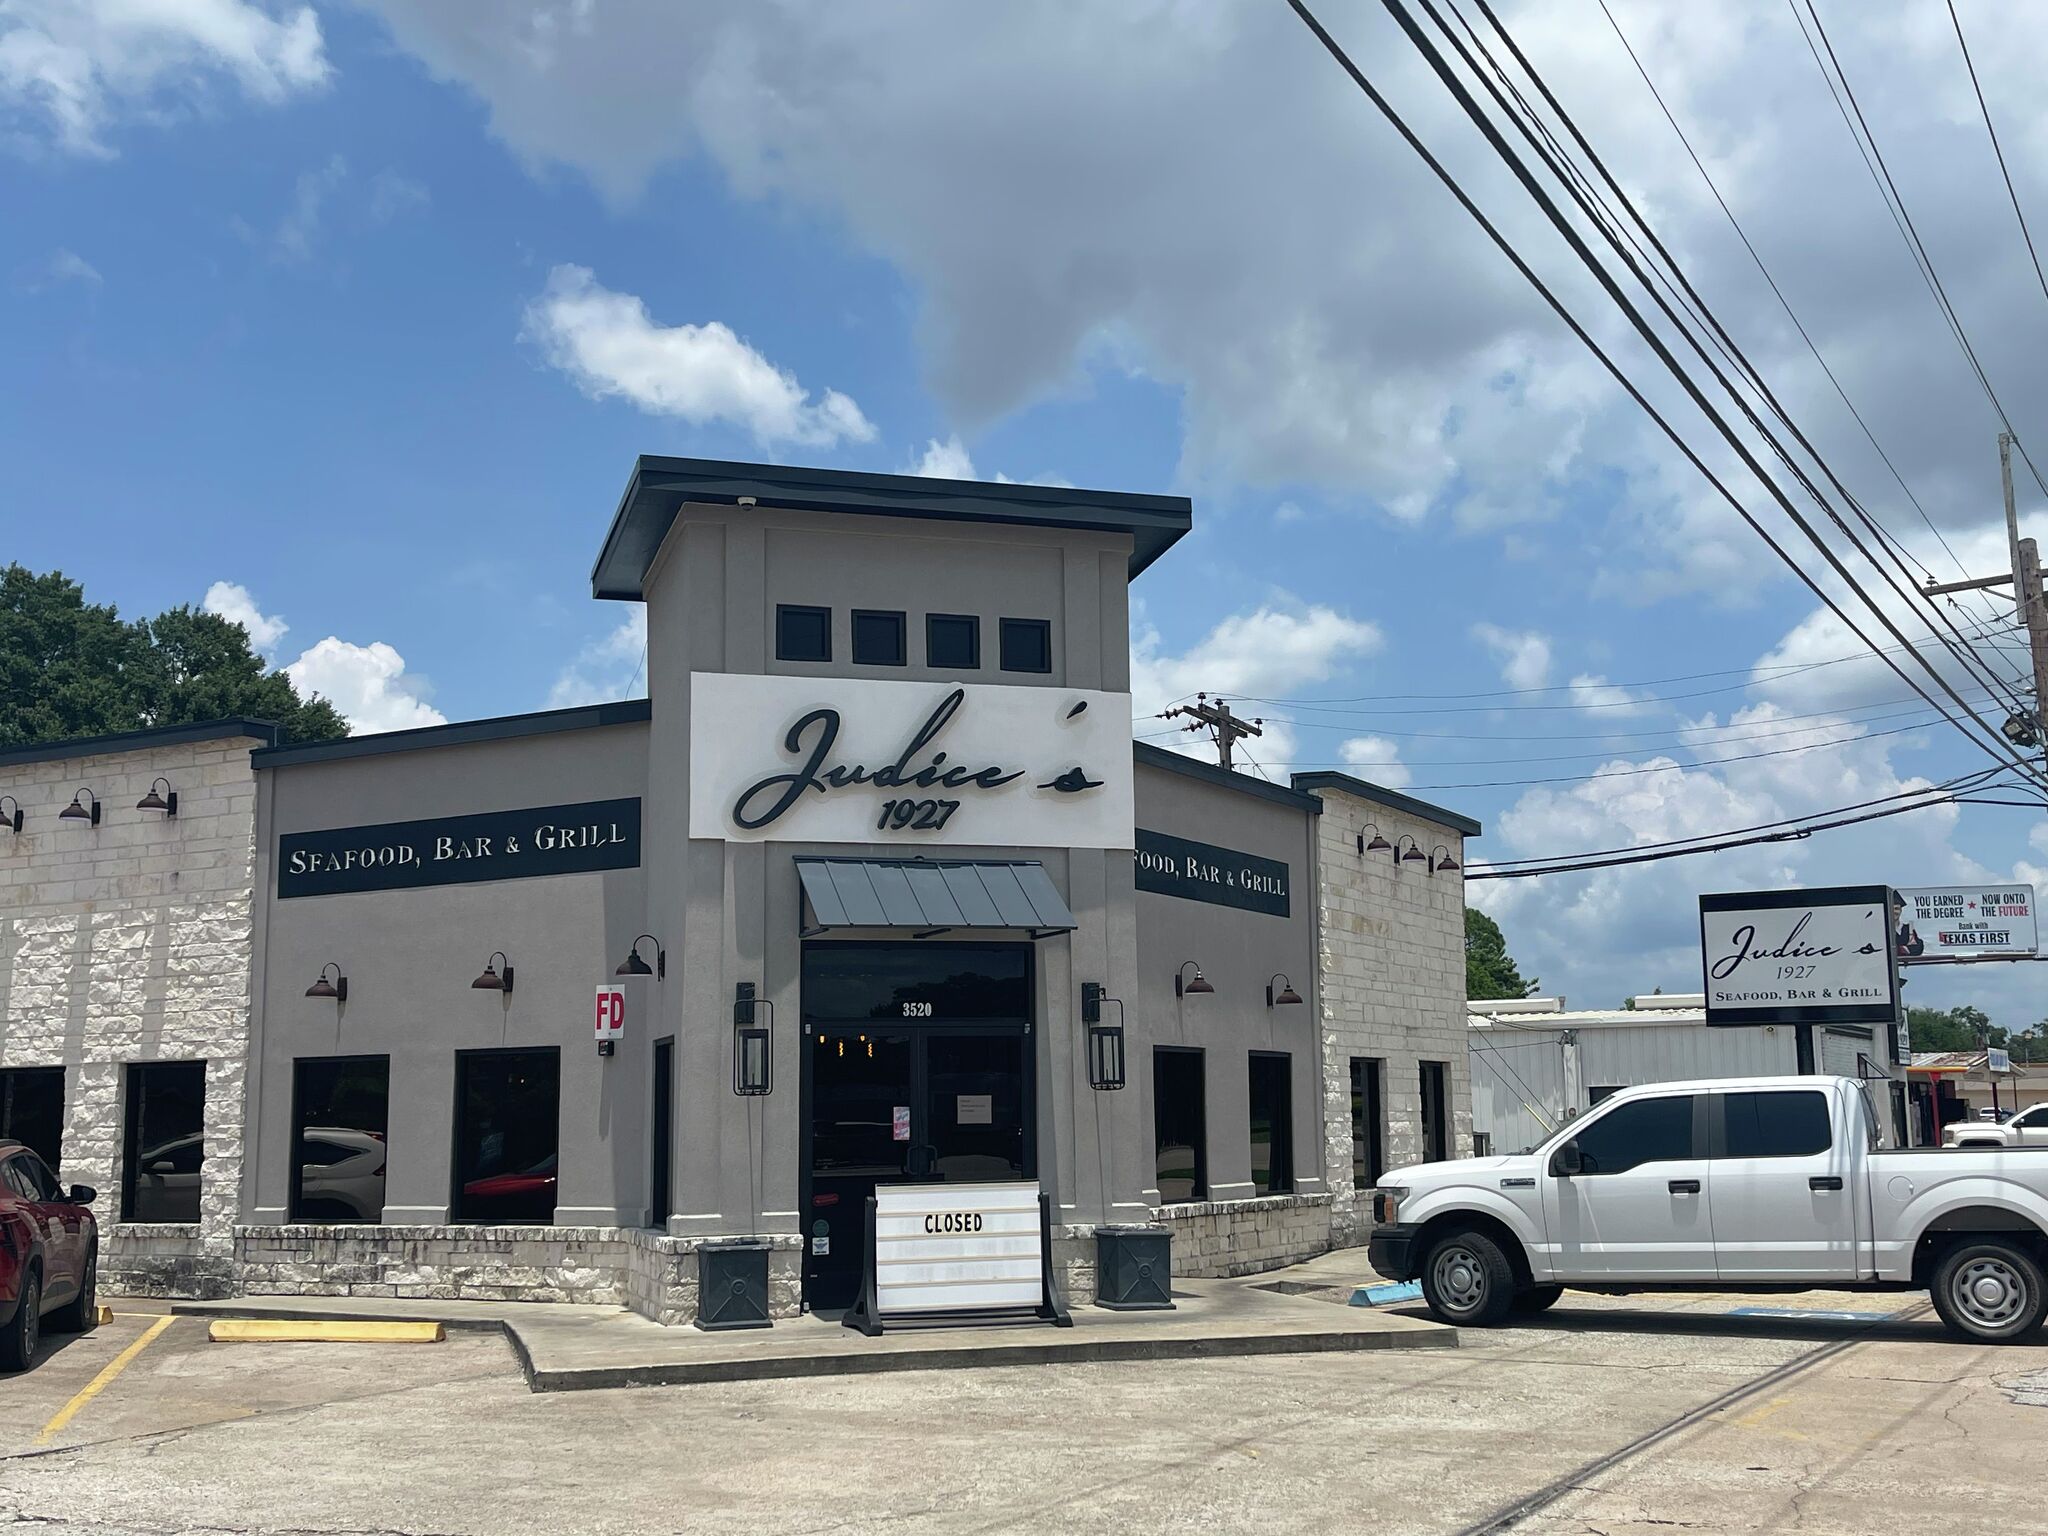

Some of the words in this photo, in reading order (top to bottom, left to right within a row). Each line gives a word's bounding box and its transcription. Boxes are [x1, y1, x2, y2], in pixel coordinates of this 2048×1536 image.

[876, 798, 960, 831] 1927
[434, 836, 492, 861] BAR
[505, 836, 520, 854] &
[534, 823, 626, 850] GRILL
[1187, 857, 1220, 883] BAR
[1226, 871, 1235, 886] &
[1241, 868, 1285, 895] GRILL
[1914, 896, 1931, 907] YOU
[1933, 895, 1964, 907] EARNED
[1982, 894, 2001, 905] NOW
[2003, 893, 2025, 905] ONTO
[1916, 908, 1931, 919] THE
[1933, 907, 1964, 919] DEGREE
[1981, 906, 1996, 917] THE
[1998, 905, 2029, 917] FUTURE
[1958, 922, 1973, 930] Bank
[1975, 922, 1988, 930] with
[1942, 933, 1976, 944] TEXAS
[1979, 932, 2010, 944] FIRST
[1777, 965, 1816, 980] 1927
[1715, 991, 1782, 1002] SEAFOOD,
[1788, 989, 1816, 999] BAR
[1822, 989, 1832, 998] &
[1838, 987, 1882, 998] GRILL
[596, 993, 625, 1030] FD
[903, 1002, 932, 1017] 3520
[925, 1213, 982, 1233] CLOSED
